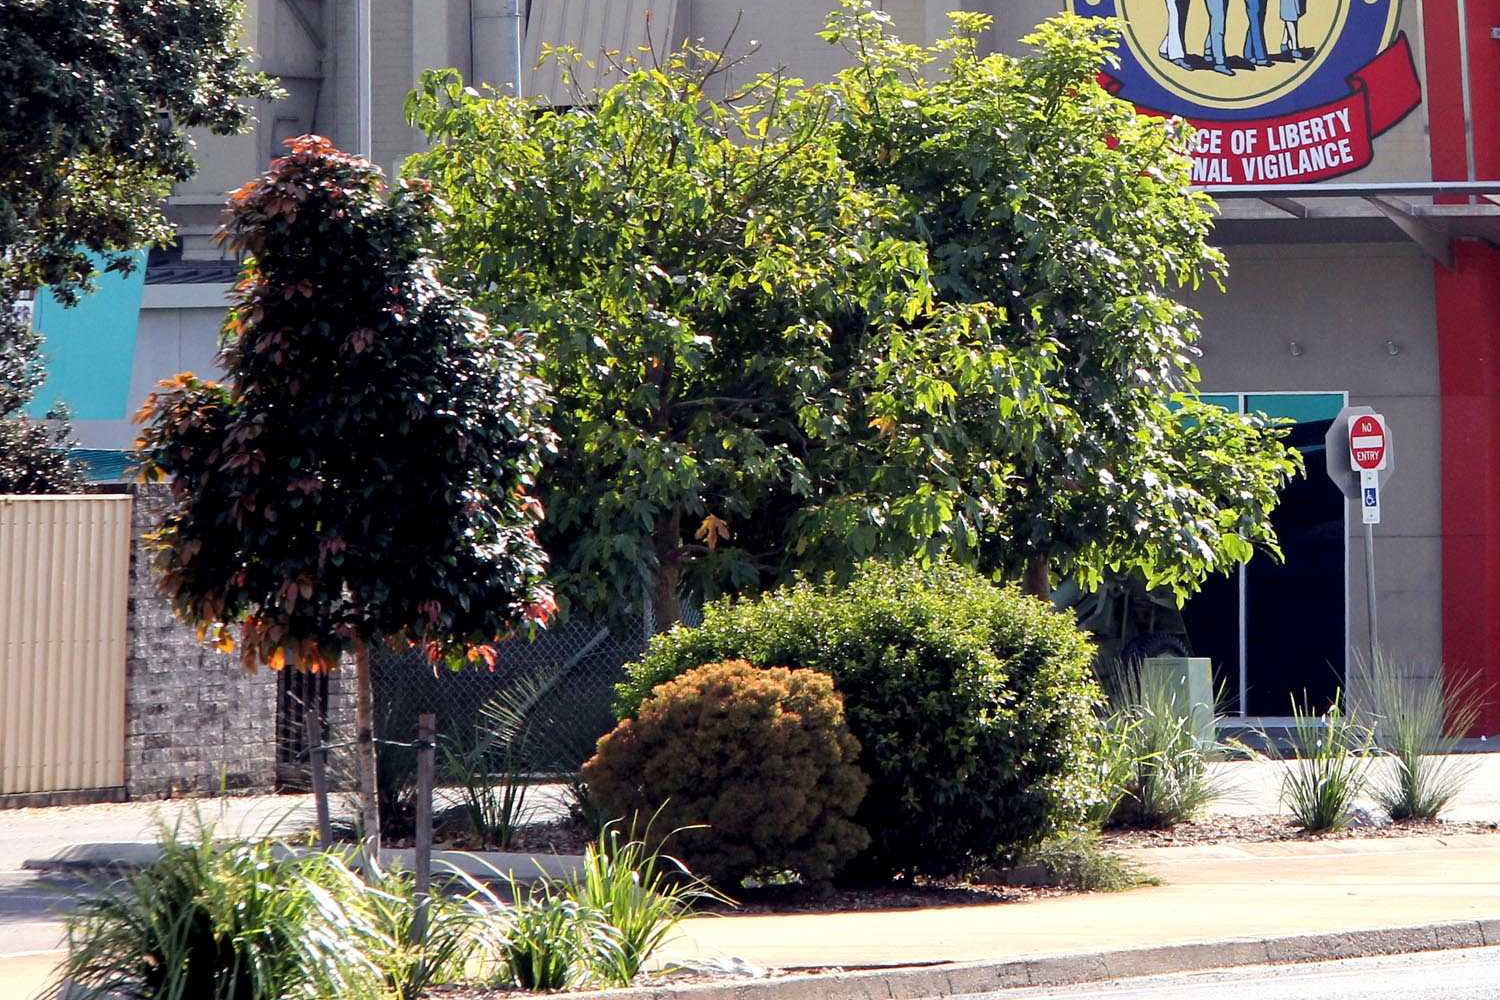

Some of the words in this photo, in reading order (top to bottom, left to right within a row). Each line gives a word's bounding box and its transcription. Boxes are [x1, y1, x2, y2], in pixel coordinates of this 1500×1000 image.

[1230, 129, 1257, 155] OF
[1266, 107, 1352, 152] LIBERTY
[1190, 156, 1232, 183] NAL
[1241, 138, 1354, 182] VIGILANCE
[1361, 422, 1373, 433] NO
[1357, 450, 1380, 462] ENTRY
